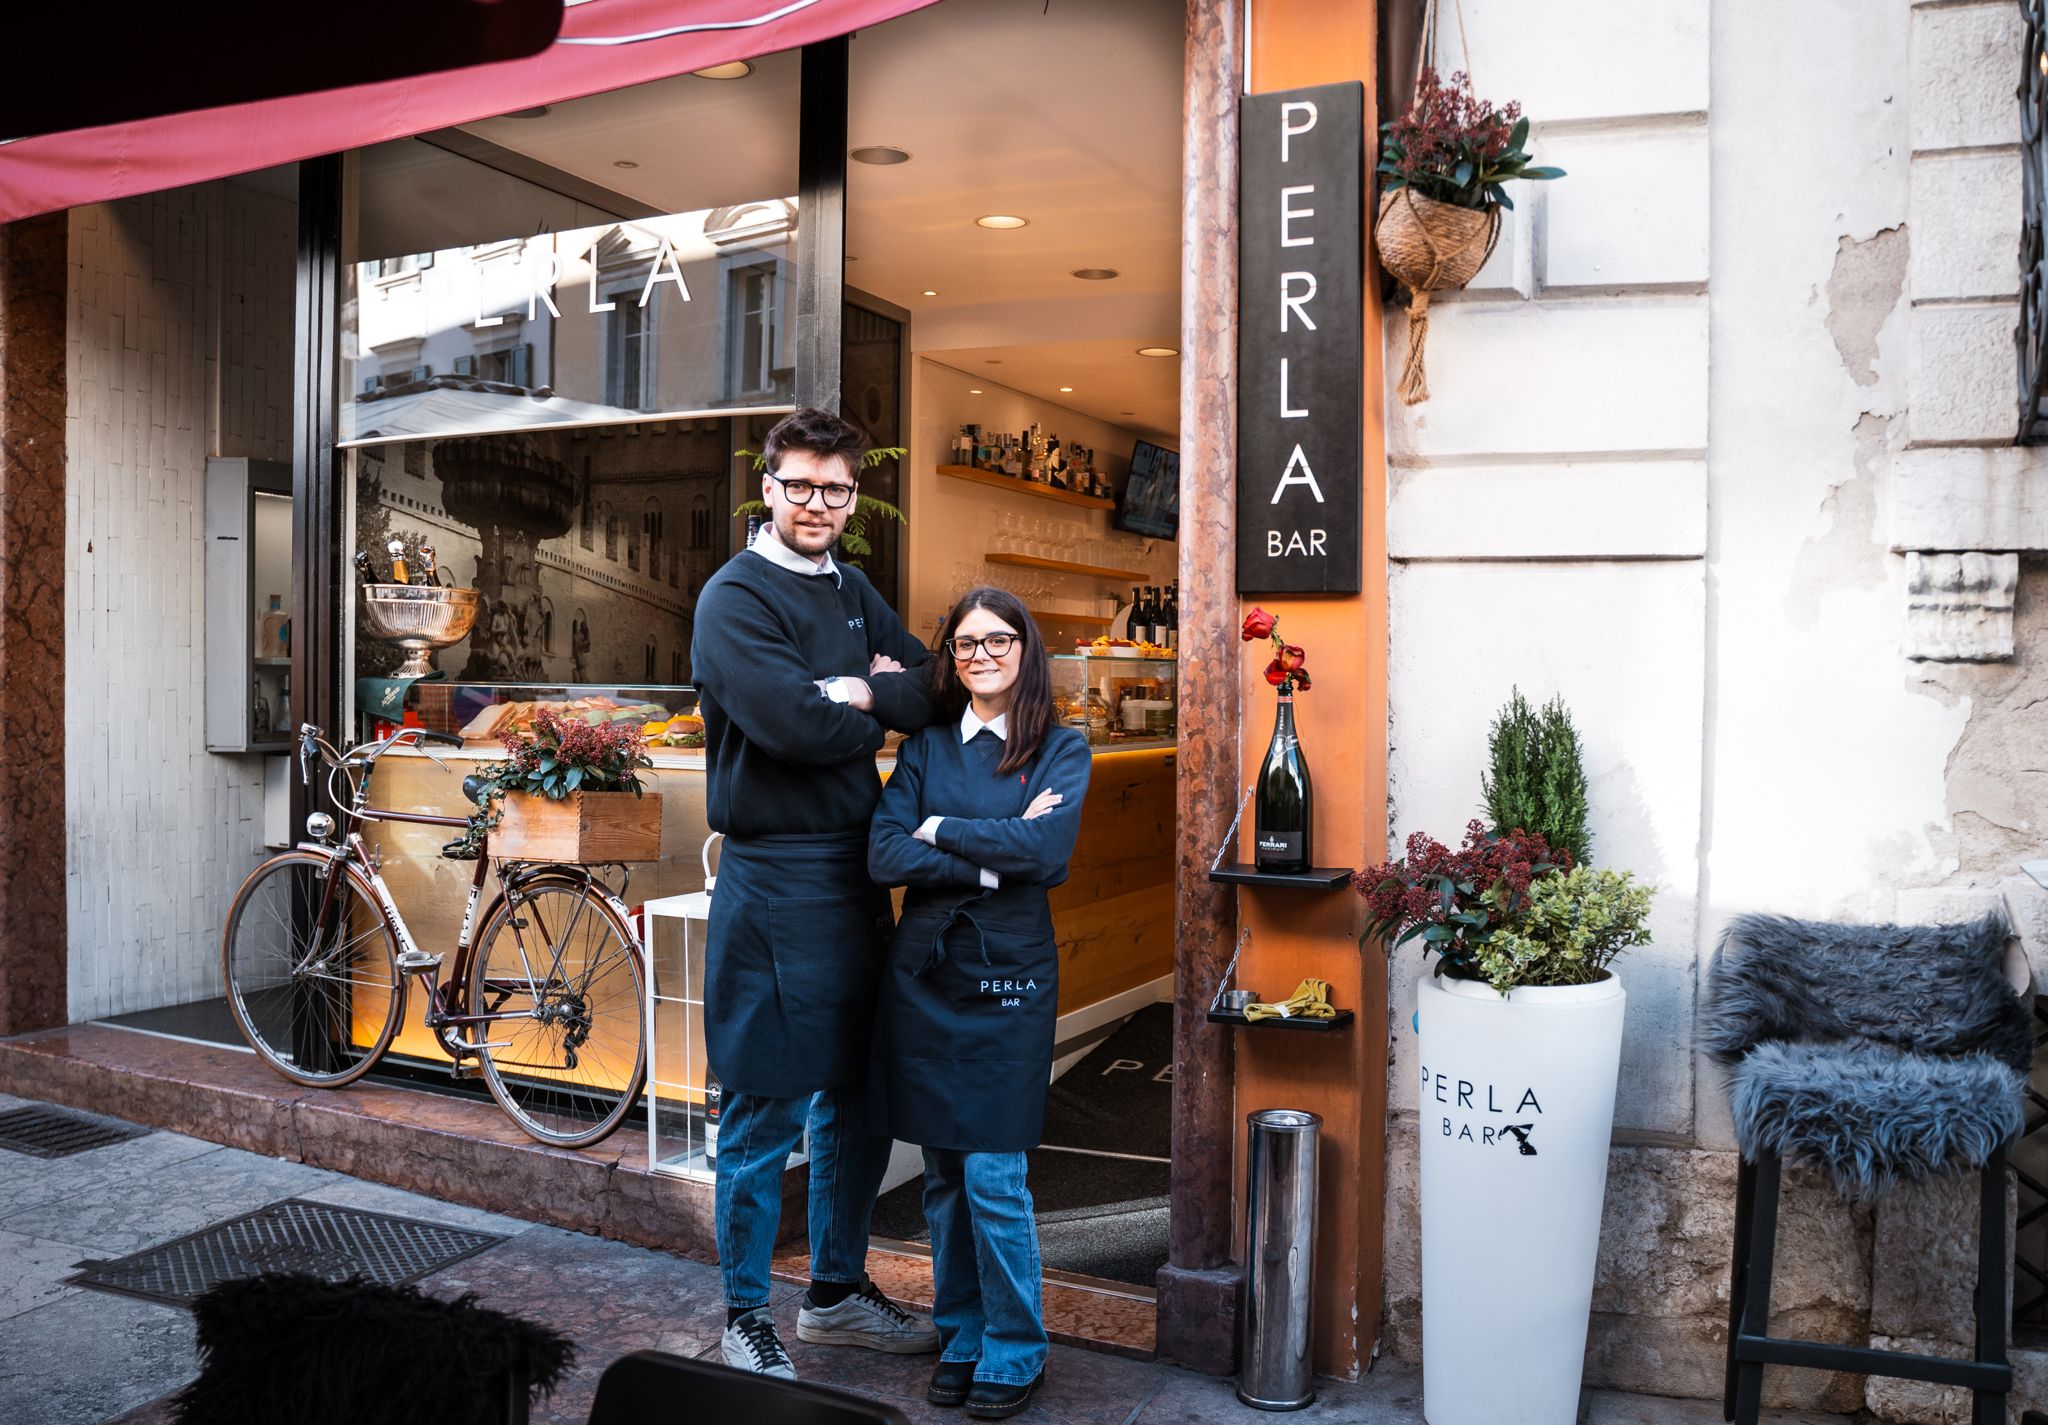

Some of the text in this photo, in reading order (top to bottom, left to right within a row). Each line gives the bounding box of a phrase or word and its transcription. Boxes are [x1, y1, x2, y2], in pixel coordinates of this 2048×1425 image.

[1271, 101, 1325, 504] PERLA
[1266, 529, 1327, 557] BAR
[980, 979, 1037, 993] PERLA
[1001, 998, 1020, 1007] BAR
[1421, 1065, 1542, 1114] PERLA
[1442, 1117, 1495, 1146] BAR
